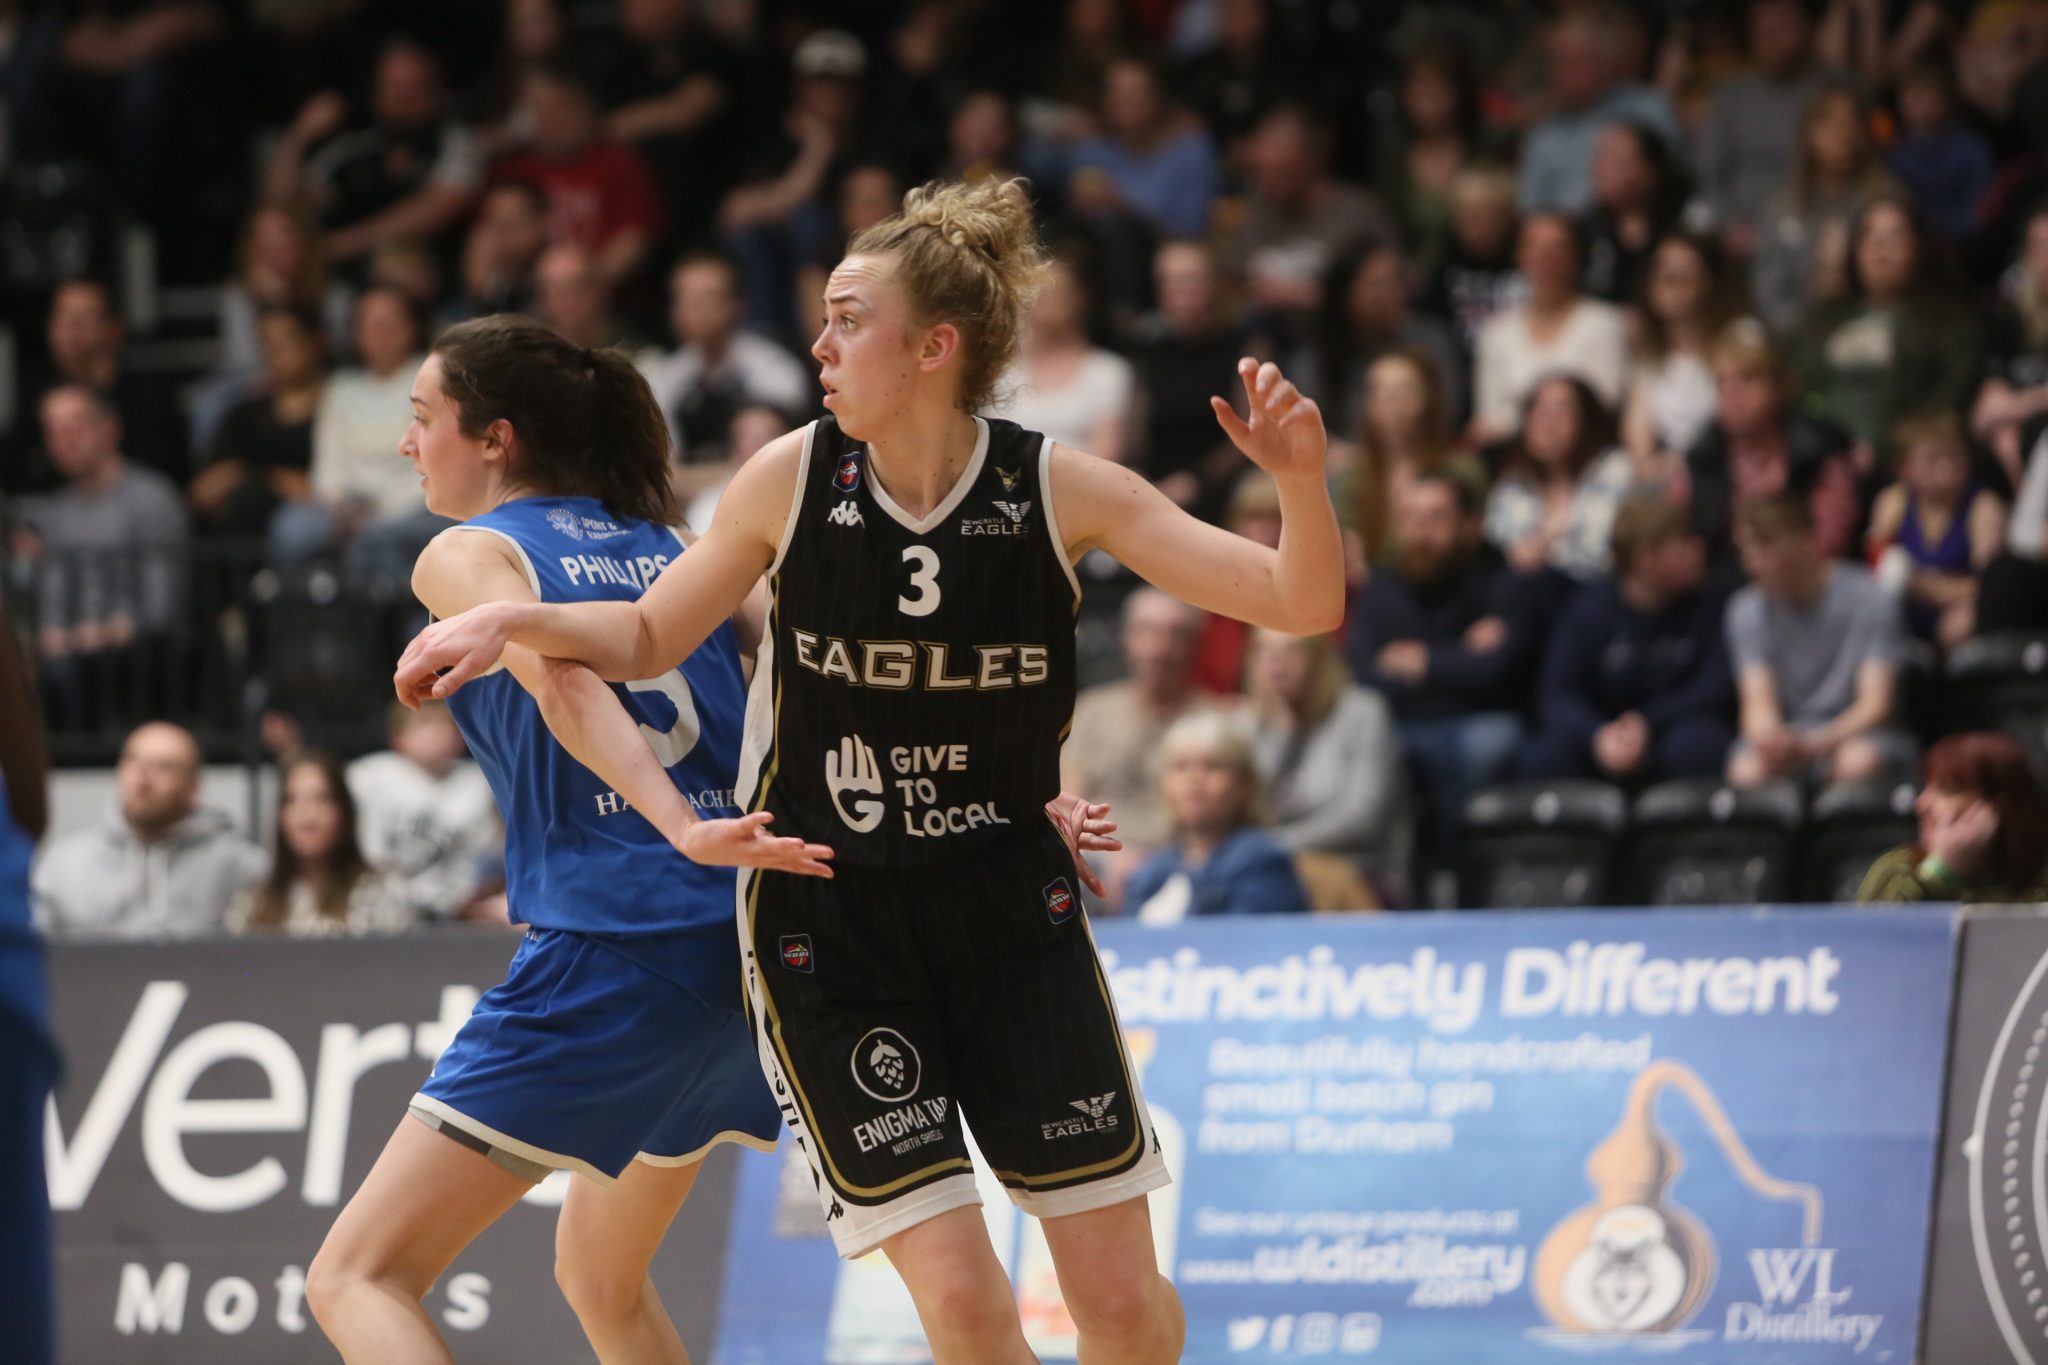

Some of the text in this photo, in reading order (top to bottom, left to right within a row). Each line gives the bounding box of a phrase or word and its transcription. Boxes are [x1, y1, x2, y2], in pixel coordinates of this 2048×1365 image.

[898, 545, 941, 617] 3
[792, 627, 1049, 691] EAGLES
[890, 744, 968, 774] GIVE
[895, 778, 937, 806] TO
[904, 801, 1010, 837] LOCAL
[1502, 941, 1841, 1018] Different
[853, 1096, 947, 1153] ENIGMA TAP
[892, 1136, 922, 1156] NORTH
[1043, 1115, 1118, 1140] EAGLES
[114, 1262, 492, 1334] Mots
[1748, 1247, 1853, 1305] WL
